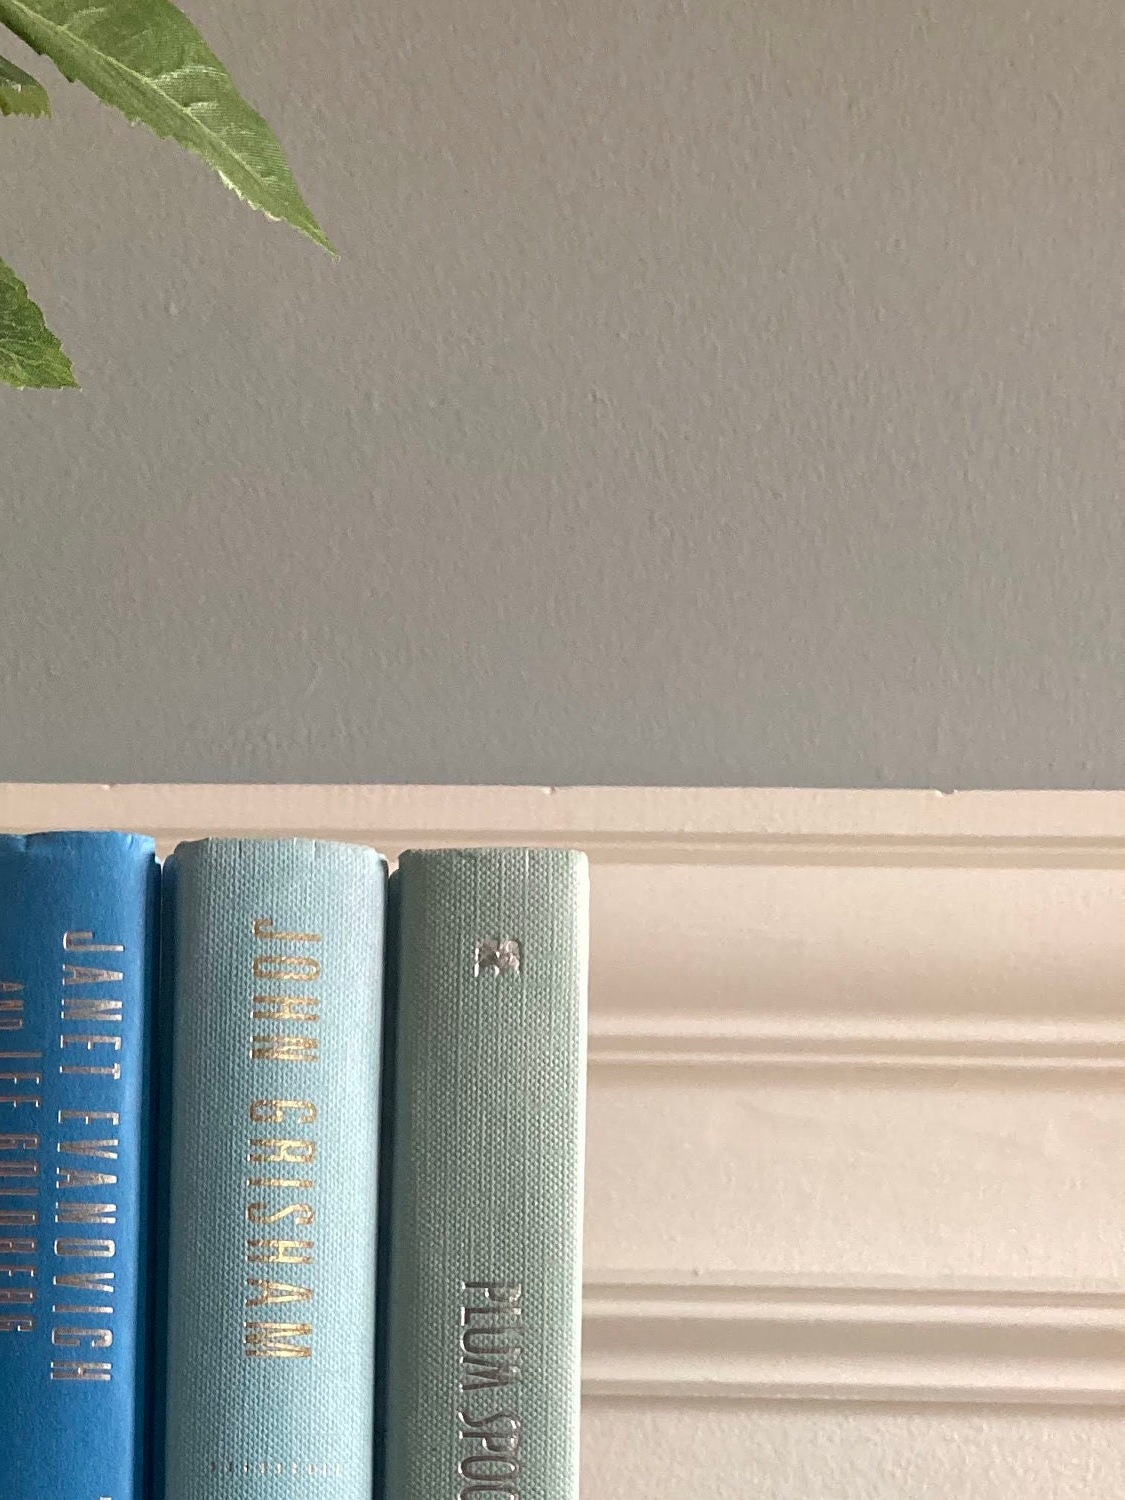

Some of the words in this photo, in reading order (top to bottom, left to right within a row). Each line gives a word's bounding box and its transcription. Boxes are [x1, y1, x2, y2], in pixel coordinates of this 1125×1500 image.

[60, 931, 124, 1080] JANET
[249, 918, 323, 1063] JOHN
[50, 1108, 120, 1382] EVANOVICH
[243, 1099, 317, 1359] GRISHAM
[459, 1281, 522, 1393] PLUM
